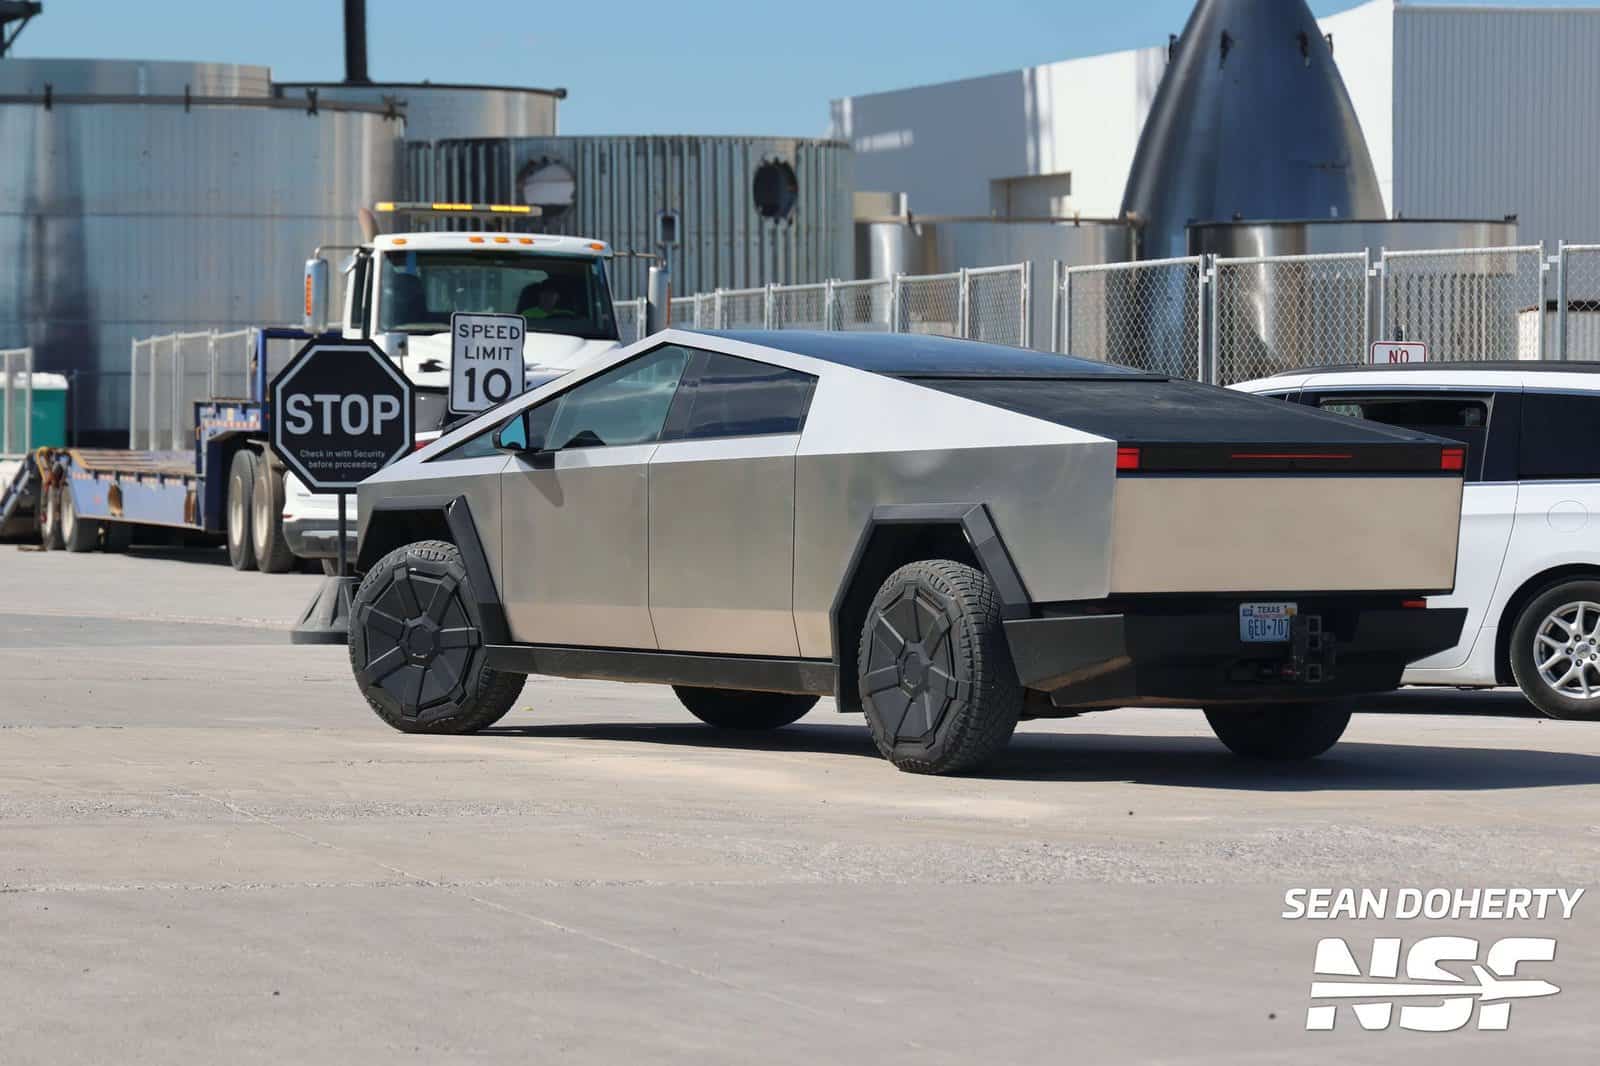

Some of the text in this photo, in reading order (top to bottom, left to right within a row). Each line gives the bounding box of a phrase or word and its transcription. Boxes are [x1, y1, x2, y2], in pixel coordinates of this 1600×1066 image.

[458, 324, 520, 340] SPEED
[464, 346, 513, 361] LIMIT
[1389, 350, 1409, 364] NO
[464, 367, 512, 403] 10
[285, 393, 400, 435] STOP
[300, 449, 385, 460] Check in with Security
[308, 460, 378, 471] before proceeding
[1257, 606, 1281, 614] TEXAS
